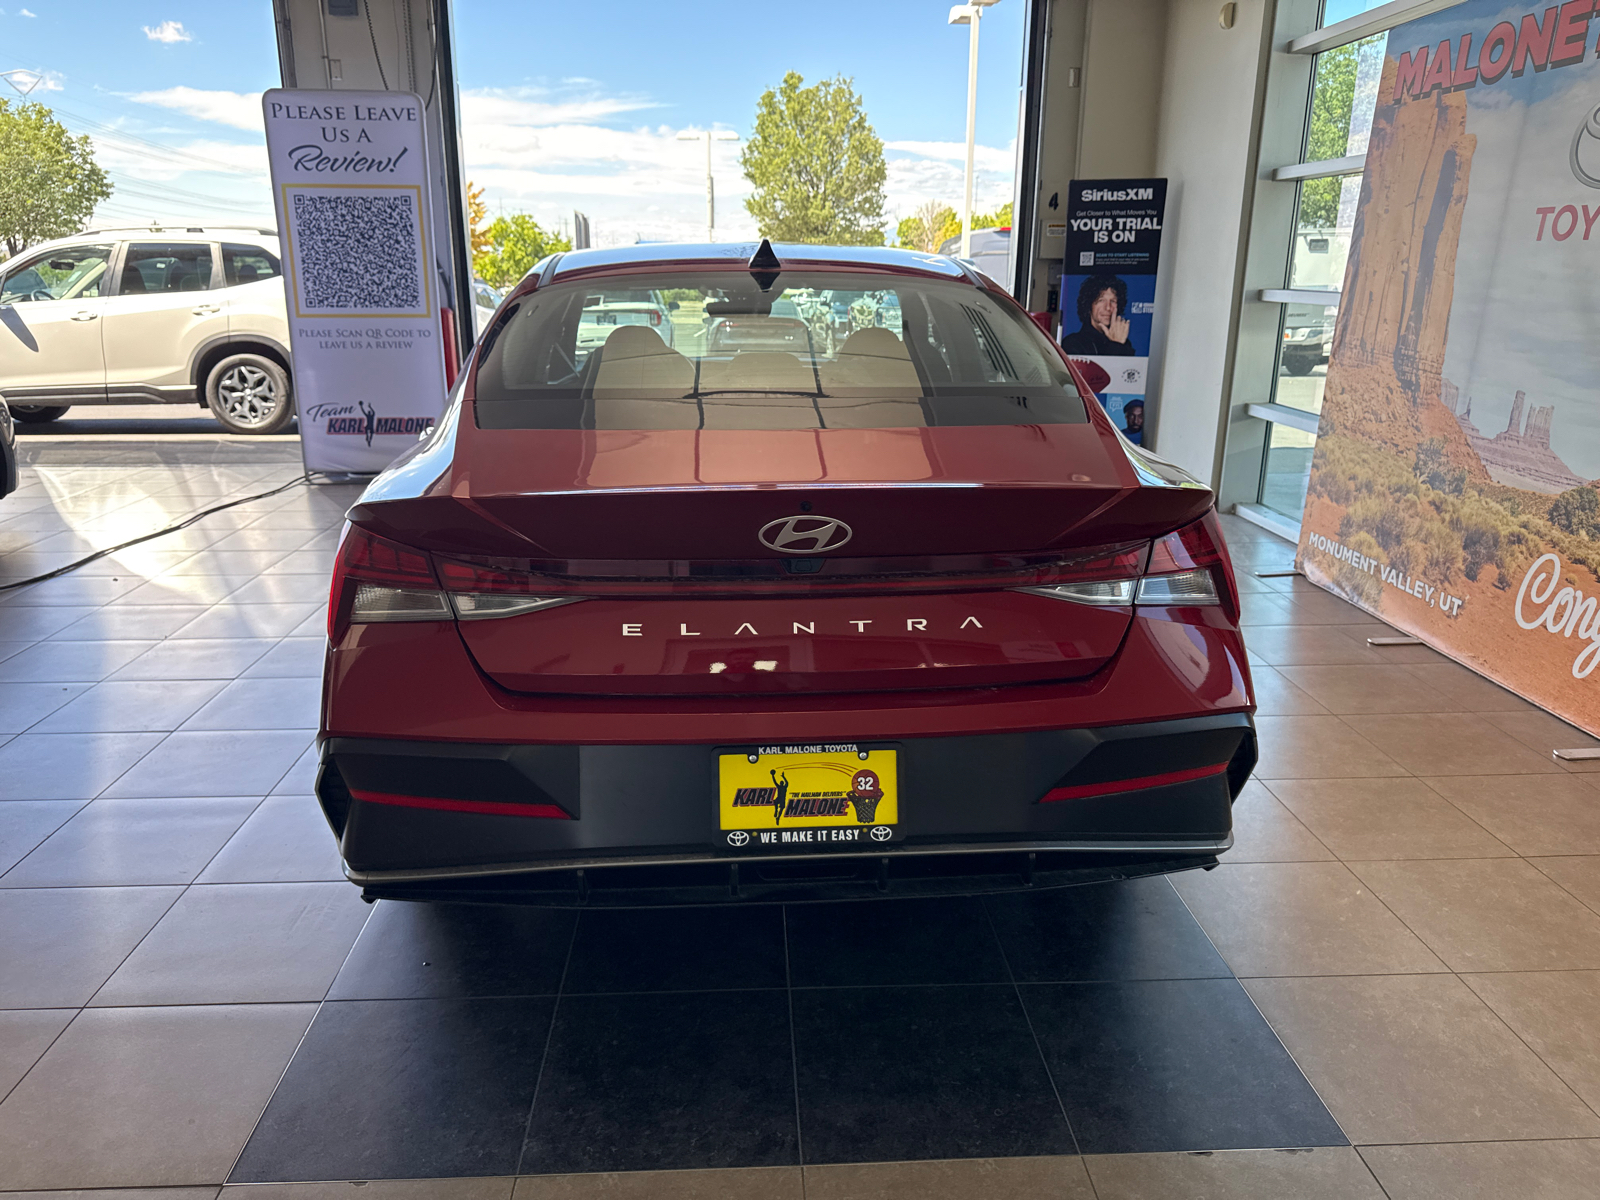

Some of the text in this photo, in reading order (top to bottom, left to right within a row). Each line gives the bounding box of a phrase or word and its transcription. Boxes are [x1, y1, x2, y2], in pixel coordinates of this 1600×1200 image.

[1393, 0, 1593, 106] MALONE
[270, 102, 417, 122] PLEASE LEAVE
[356, 128, 373, 144] A
[287, 144, 409, 173] Review!
[1048, 192, 1059, 211] 4
[1081, 188, 1153, 202] SiriusXM
[1070, 218, 1113, 231] YOUR
[1116, 217, 1162, 230] TRIAL
[1093, 230, 1136, 244] IS ON
[299, 329, 333, 338] PLEASE
[365, 329, 383, 340] QR
[319, 341, 413, 350] LEAVE US A REVIEW
[306, 402, 357, 423] Team
[327, 417, 366, 434] KARL
[1308, 531, 1462, 616] MONUMENT VALLEY, UT
[622, 616, 983, 637] ELANTRA
[758, 744, 858, 755] KARL MALONE TOYOTA
[857, 777, 874, 791] 32
[733, 788, 850, 818] KARL MALONE
[760, 829, 860, 844] WE MAKE IT EASY
